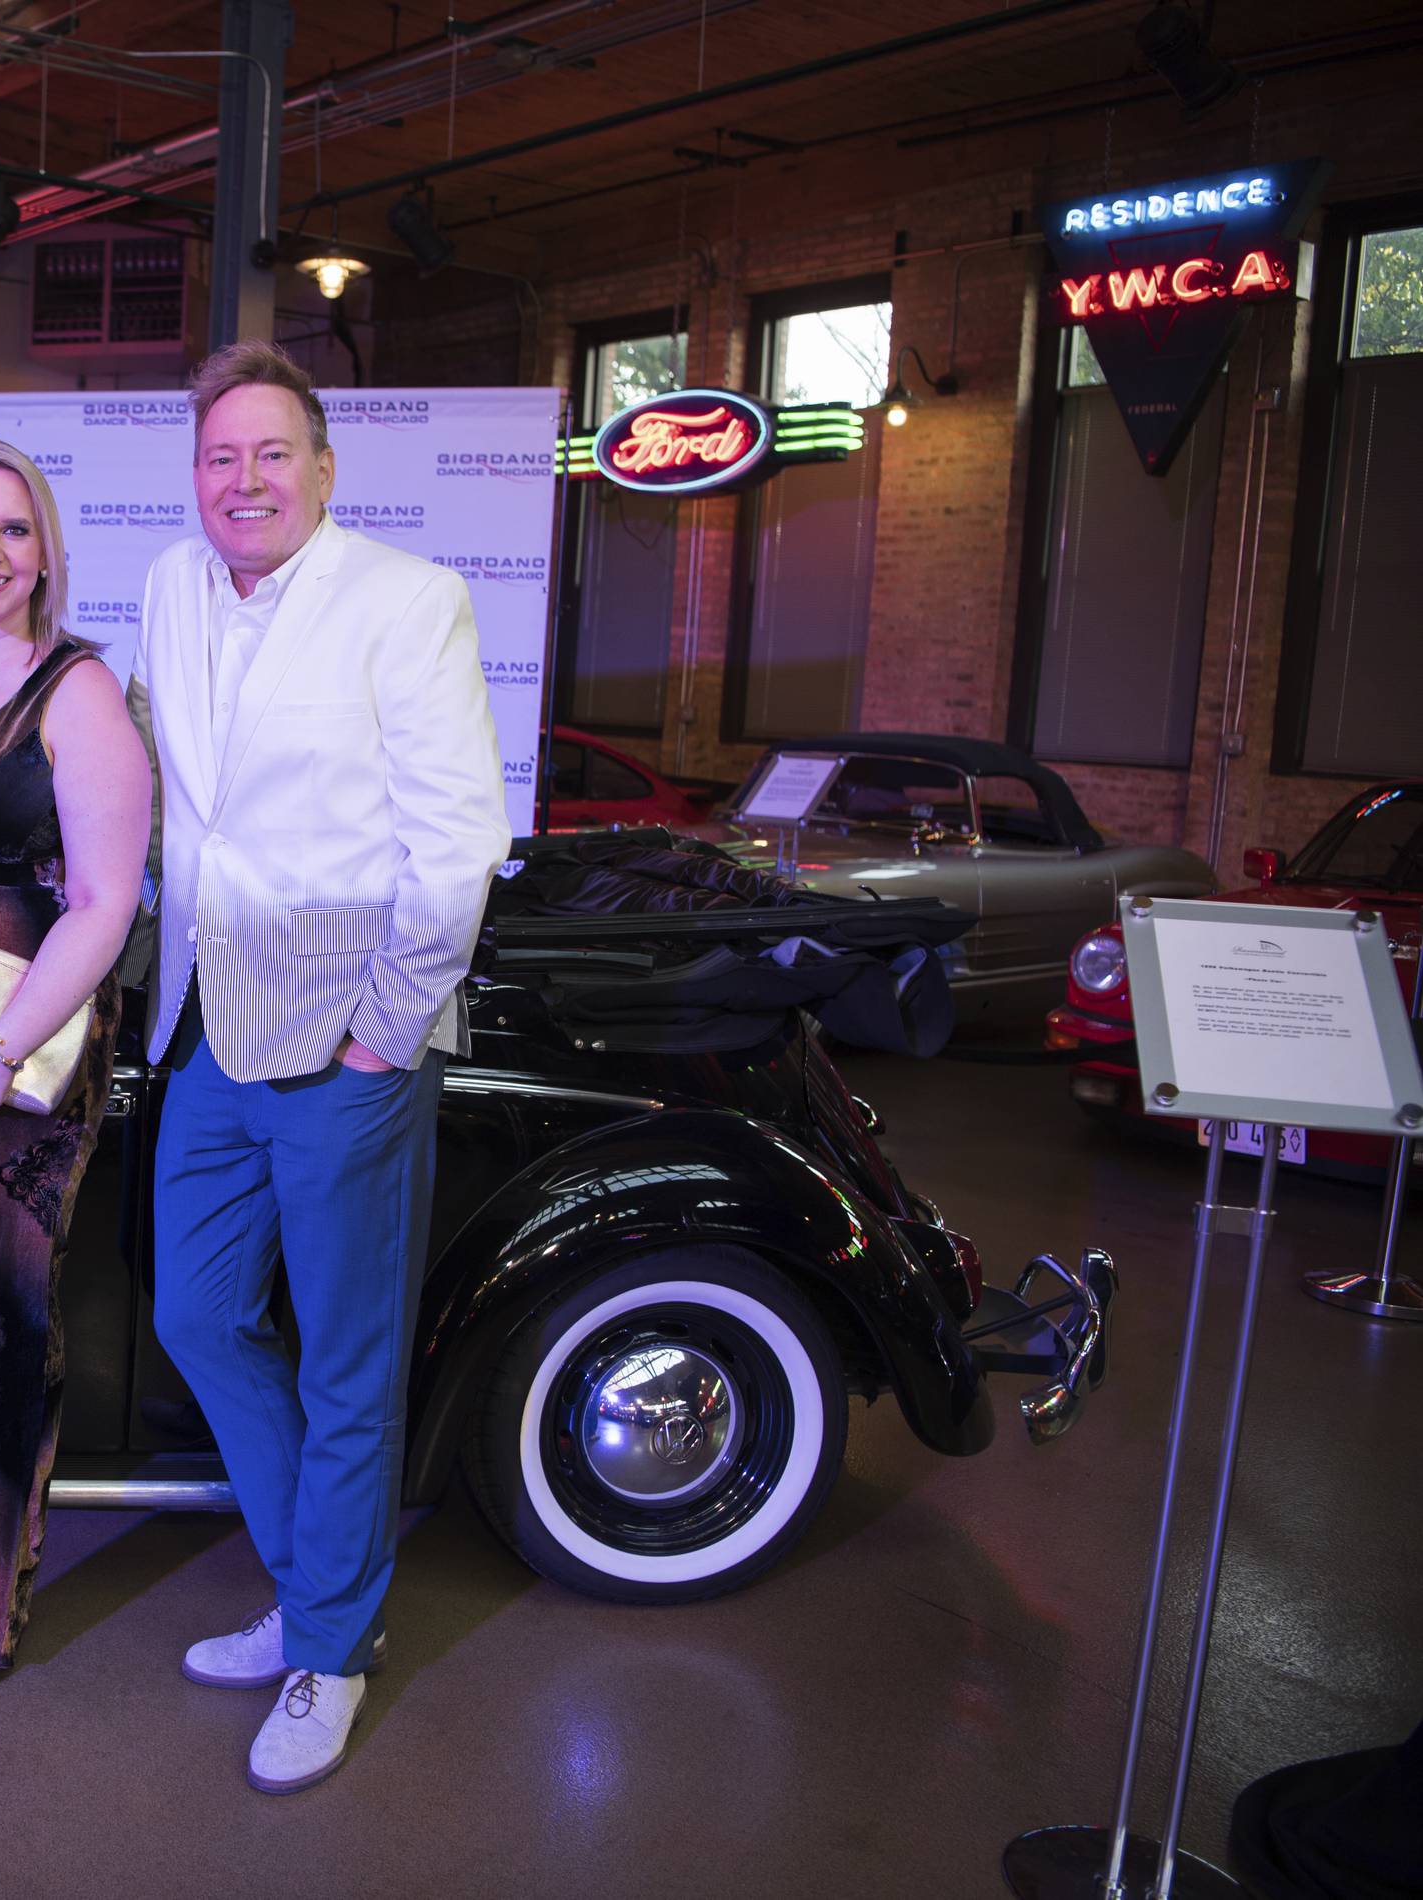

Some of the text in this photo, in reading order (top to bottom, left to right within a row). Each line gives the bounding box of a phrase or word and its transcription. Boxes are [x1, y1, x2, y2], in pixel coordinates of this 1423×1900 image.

[1065, 177, 1271, 231] RESIDENCE
[83, 403, 189, 415] GIORDANO
[321, 400, 429, 413] GIORDANO
[83, 416, 189, 426] DANCE CHICAGO
[327, 415, 429, 424] ANCE CHICAGO
[613, 406, 750, 473] Ford
[437, 453, 552, 465] GIORDANO
[436, 466, 551, 477] DANCE CHICAGO
[80, 503, 185, 515] GIORDANO
[329, 505, 425, 517] IORDANO
[80, 517, 185, 526] DANCE CHICAGO
[363, 519, 424, 528] CHICAGO
[432, 556, 546, 568] GIORDANO
[483, 571, 545, 580] CHICAGO
[78, 601, 138, 613] GIORD
[77, 615, 120, 624] DANCE
[485, 676, 539, 685] HICAGO
